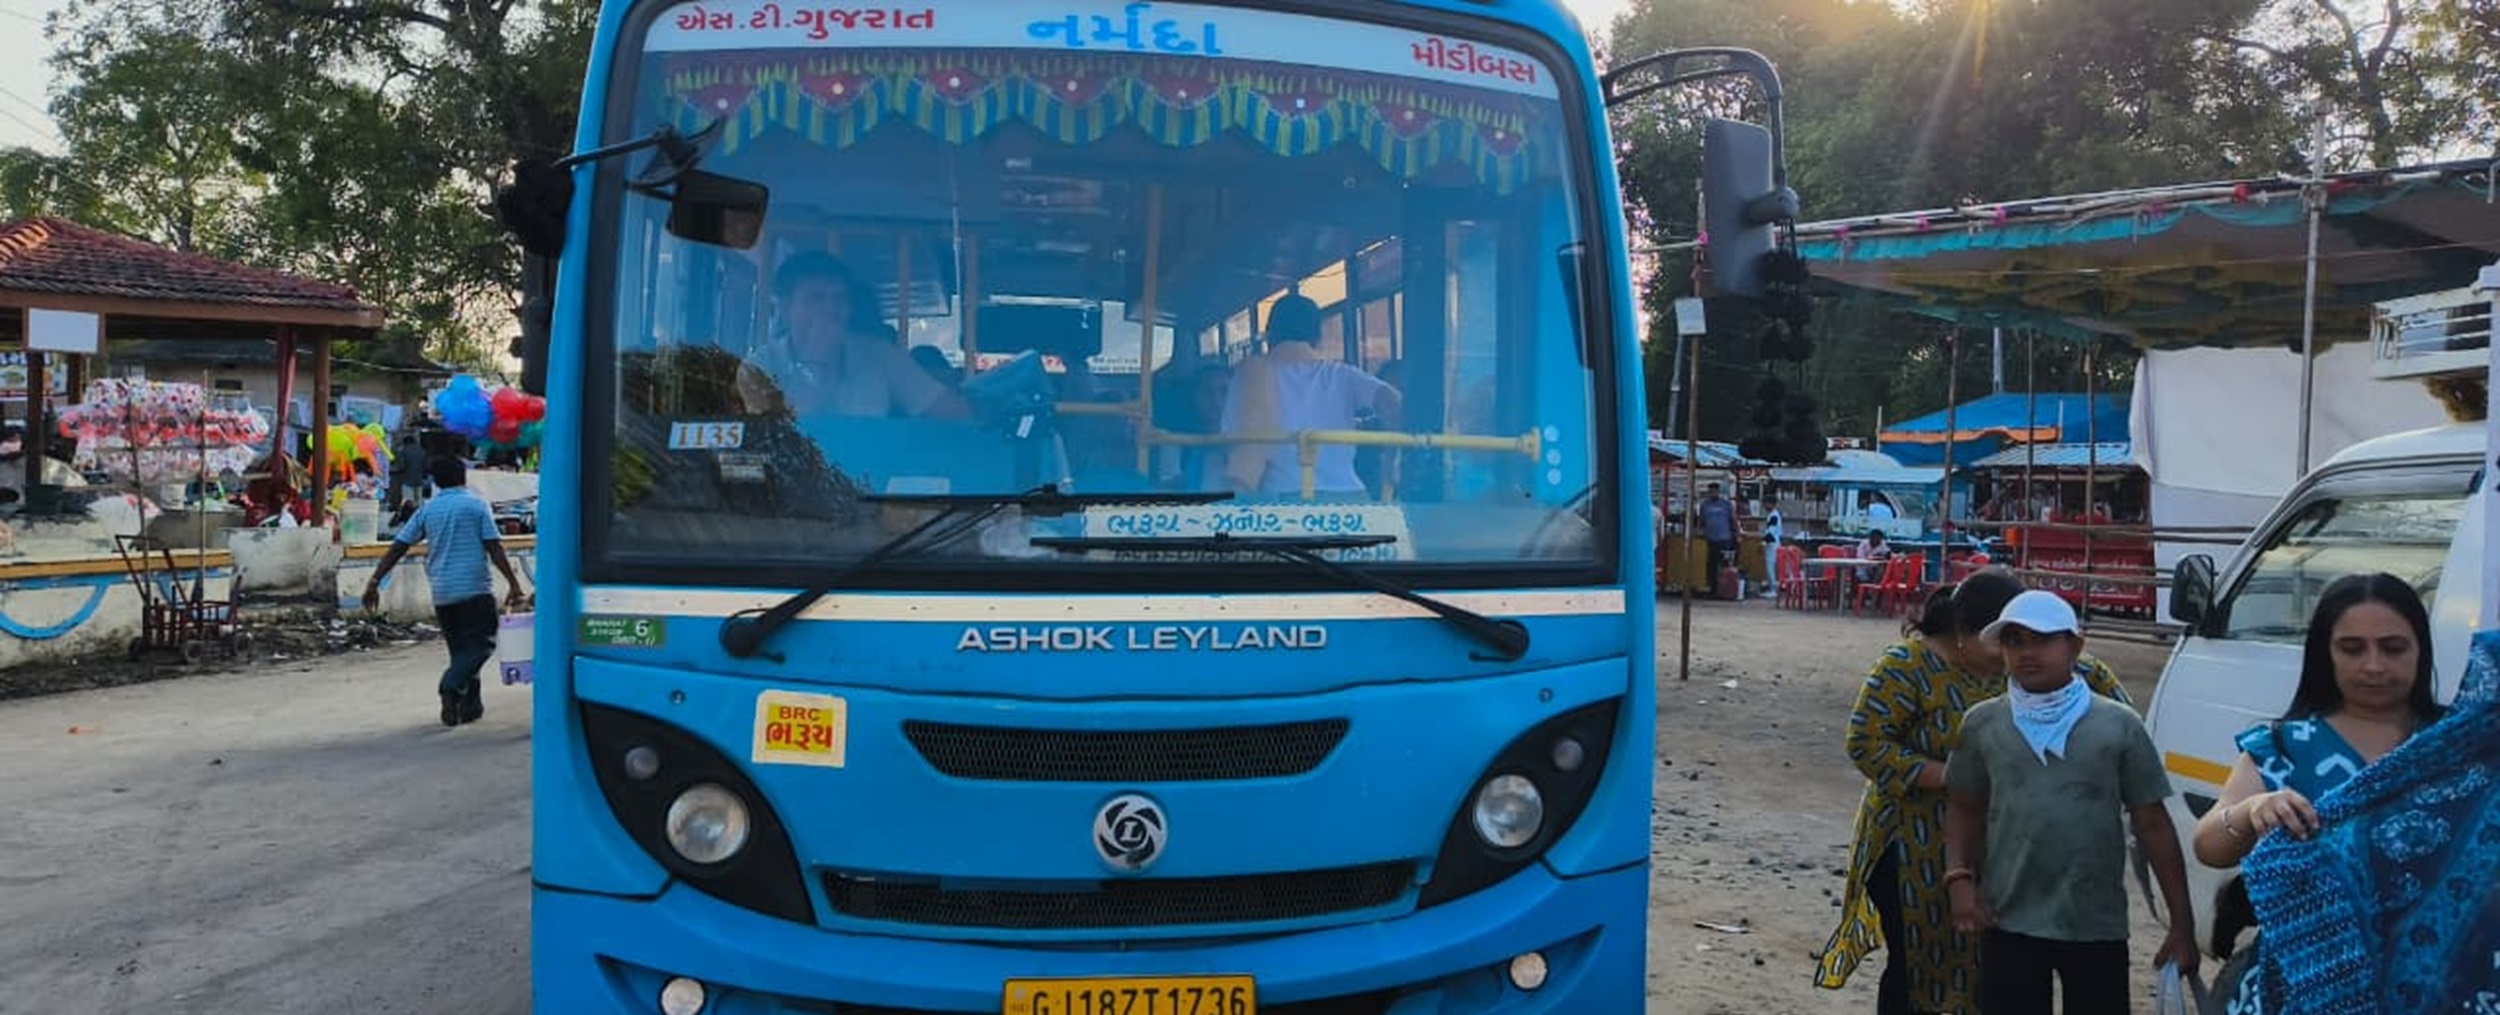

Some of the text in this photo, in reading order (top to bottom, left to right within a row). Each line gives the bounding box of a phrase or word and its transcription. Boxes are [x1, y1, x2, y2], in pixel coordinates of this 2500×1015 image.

[1027, 3, 1223, 54] નર્મદા
[1410, 37, 1537, 84] મીડીબસ
[678, 424, 740, 448] 1135
[635, 619, 650, 636] 6
[957, 625, 1327, 651] ASHOK LEYLAND
[779, 706, 822, 721] BRC
